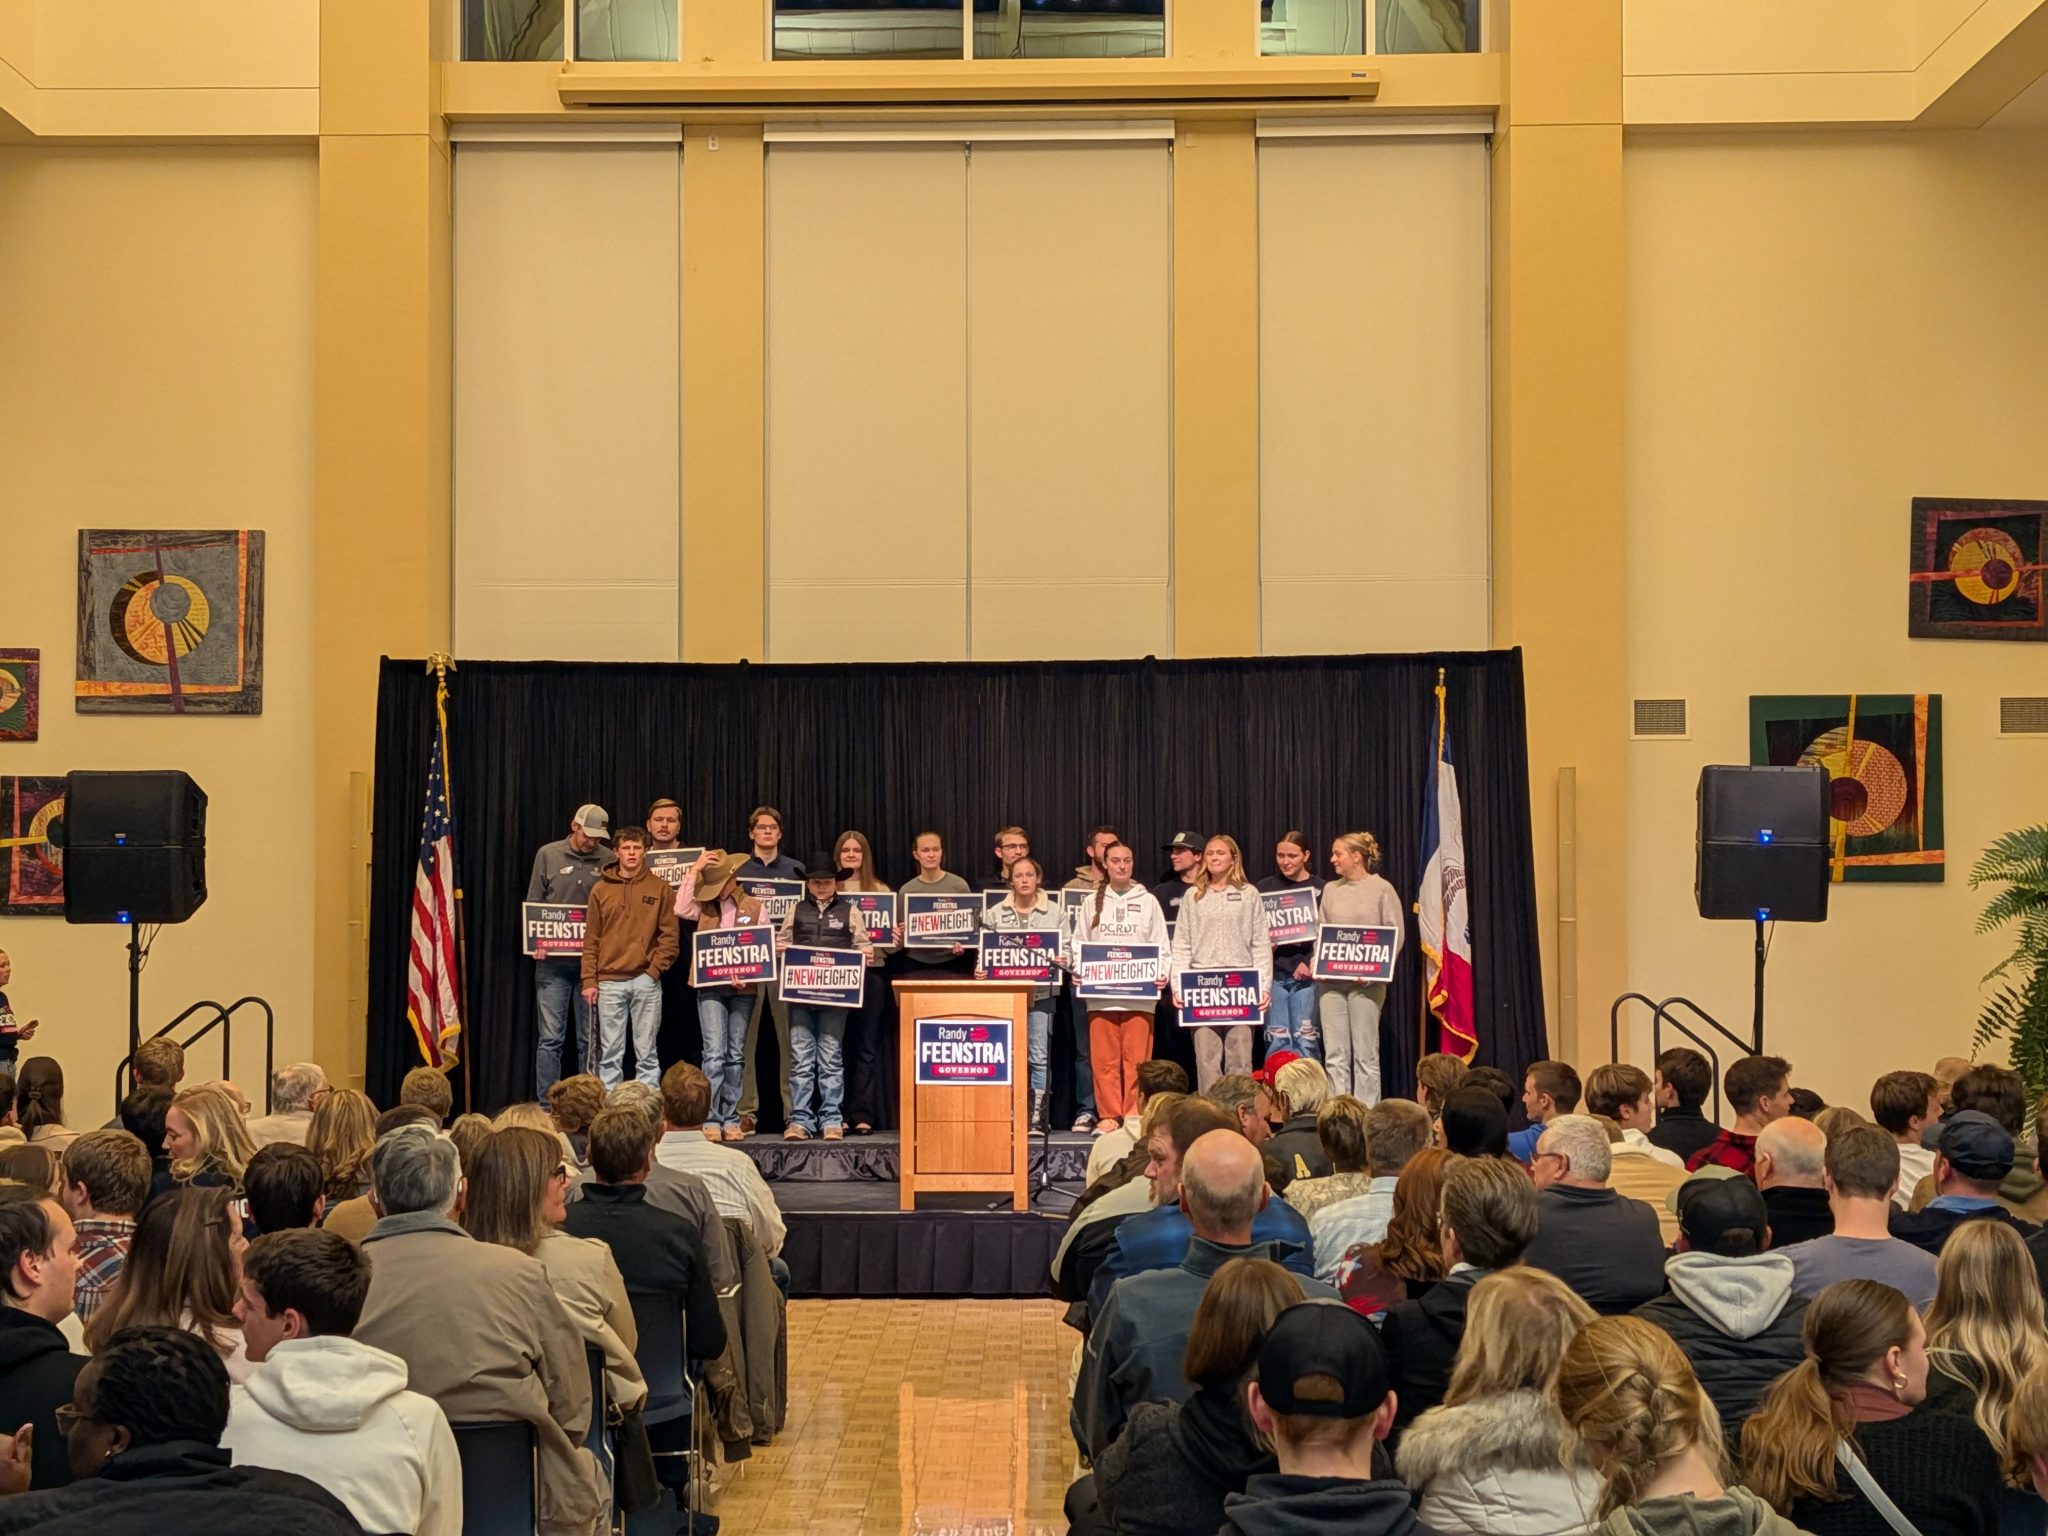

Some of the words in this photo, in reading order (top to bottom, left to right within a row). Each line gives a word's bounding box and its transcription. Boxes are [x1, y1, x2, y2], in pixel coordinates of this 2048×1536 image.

[541, 908, 567, 921] Randy
[911, 912, 974, 933] #NEWHEIGHT
[1266, 905, 1313, 928] NSTRA
[528, 920, 587, 939] FEENSTR
[1336, 930, 1361, 943] Randy
[711, 933, 736, 946] Randy
[698, 944, 770, 968] FEENSTRA
[1320, 942, 1390, 963] FEENSTRA
[712, 966, 757, 975] GOVERNOR
[1084, 961, 1156, 981] #NEWHEIGHTS
[1332, 963, 1375, 971] GOVERNOR
[786, 968, 859, 986] #NEWHEIGHTS
[1197, 974, 1223, 987] Randy
[1183, 986, 1258, 1008] FEENSTRA
[1198, 1008, 1244, 1016] GOVERNOR
[938, 1026, 968, 1042] Randy
[921, 1041, 1006, 1064] FEENSTRA
[938, 1066, 989, 1074] GOVERNOR
